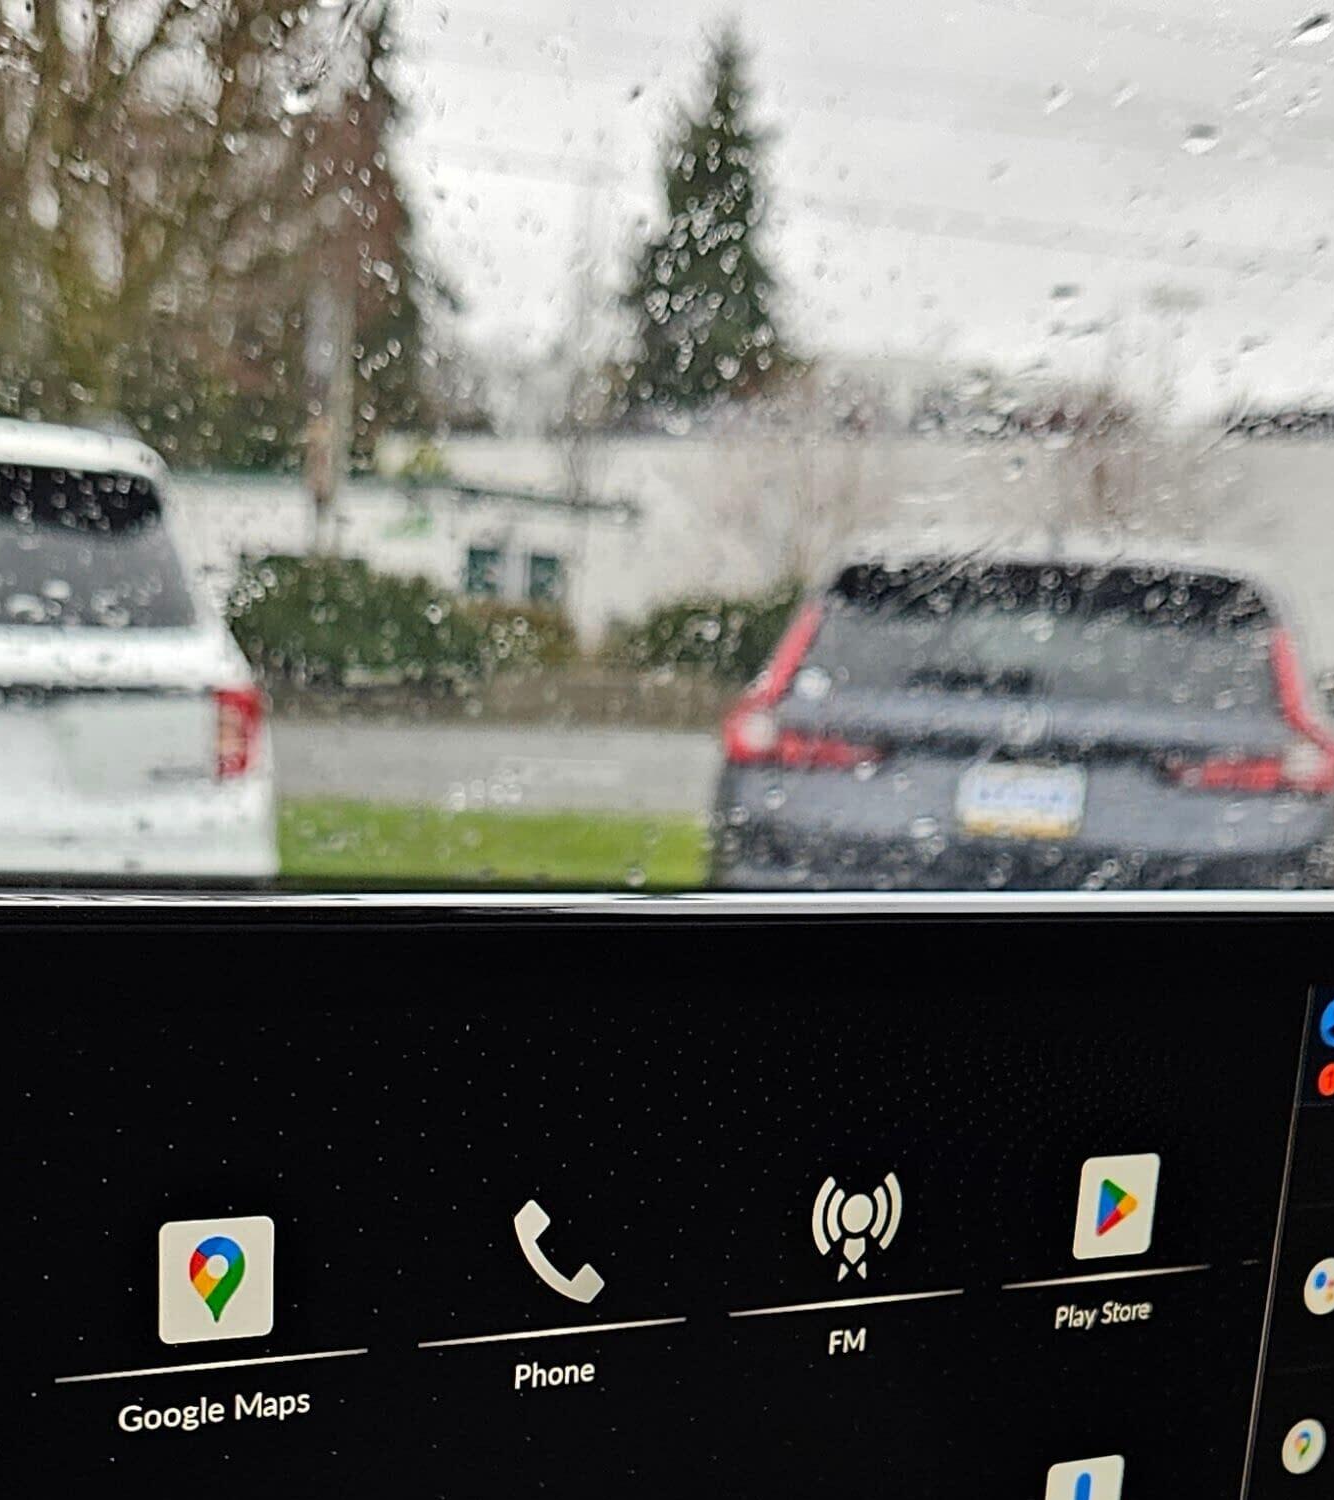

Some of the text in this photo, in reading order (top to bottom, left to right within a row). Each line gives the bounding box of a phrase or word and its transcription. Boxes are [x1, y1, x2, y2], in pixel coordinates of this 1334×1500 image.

[1054, 1300, 1152, 1330] Play Store
[828, 1327, 867, 1355] FM
[514, 1361, 596, 1390] Phone
[118, 1391, 311, 1432] Google Maps
